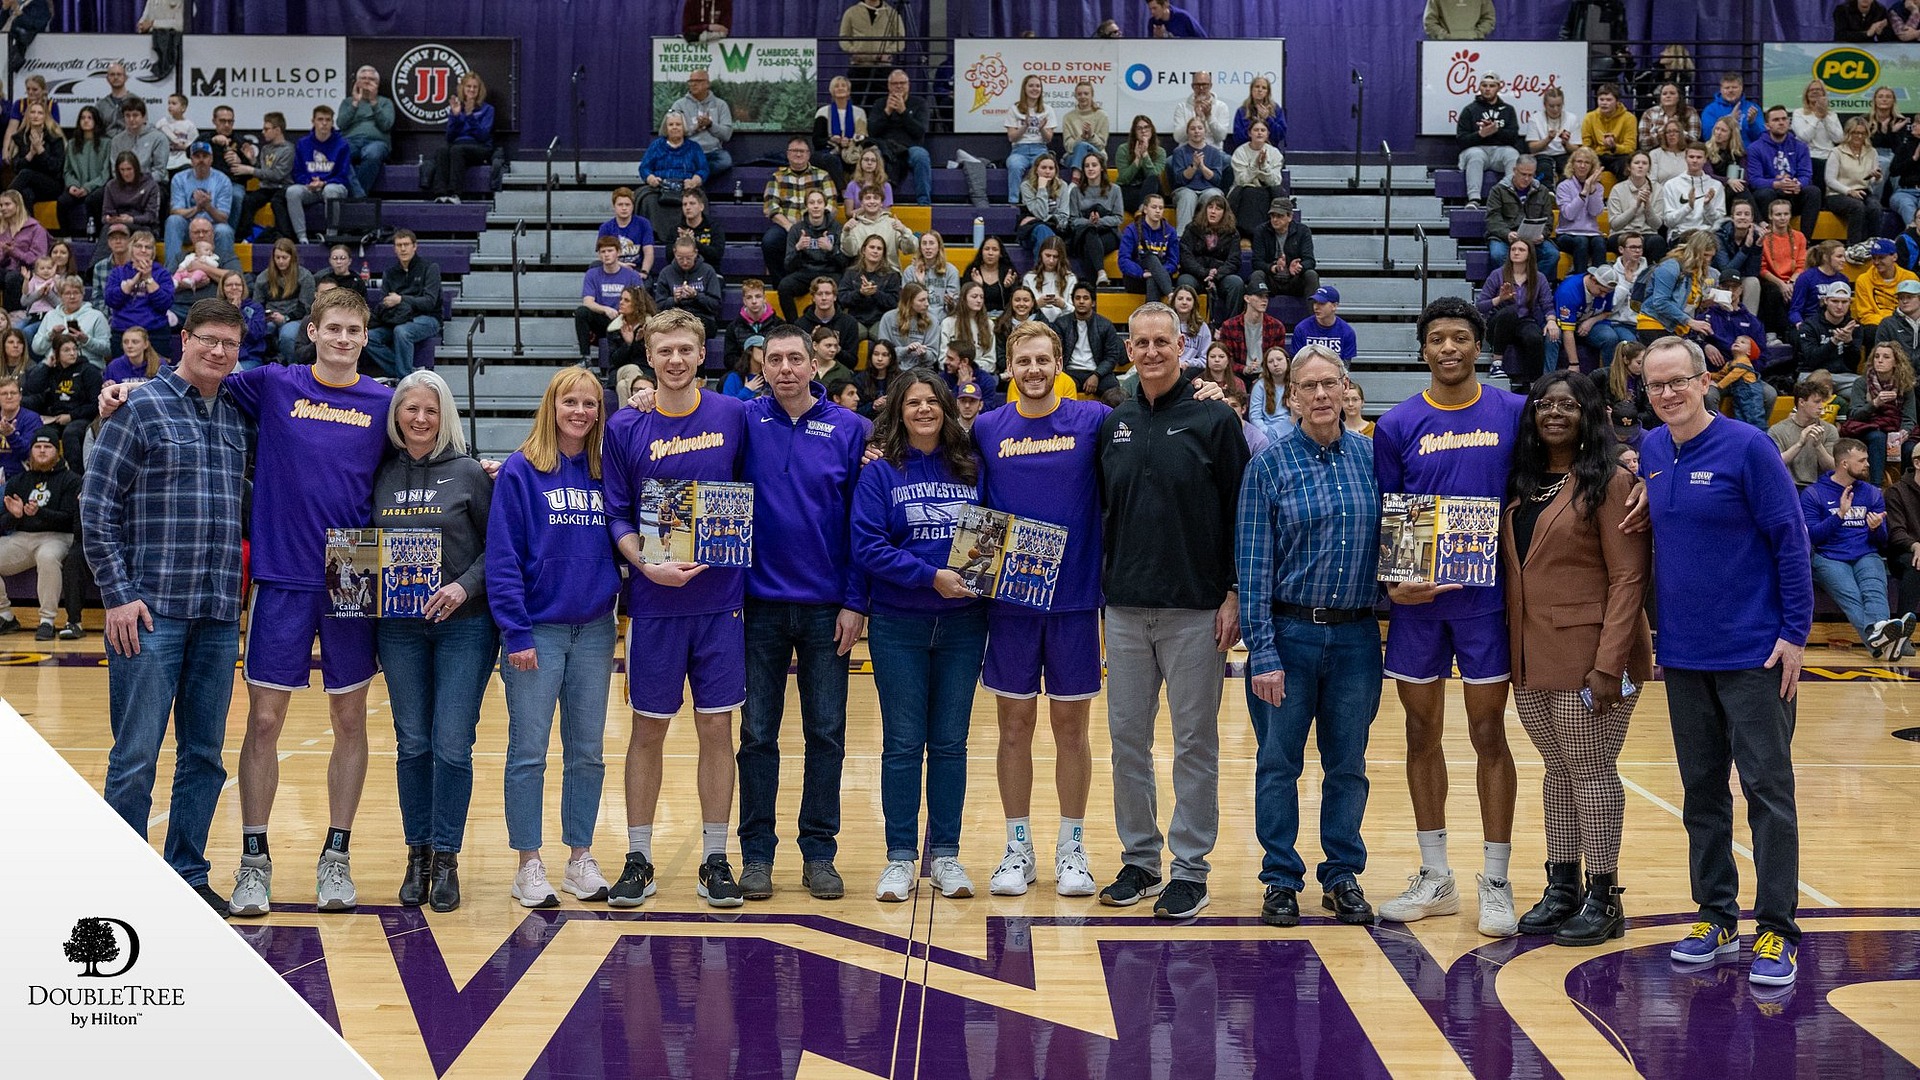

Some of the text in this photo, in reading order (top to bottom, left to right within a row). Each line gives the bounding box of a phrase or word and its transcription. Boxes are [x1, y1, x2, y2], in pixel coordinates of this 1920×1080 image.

[663, 43, 708, 53] WOLCYN
[756, 49, 815, 57] CAMBRIDGE, MN
[659, 54, 713, 63] TREE FARMS
[397, 50, 429, 85] JIMMY
[1023, 62, 1112, 71] COLD STONE
[1822, 60, 1869, 79] PCL
[231, 67, 337, 83] MILLSOP
[1039, 75, 1106, 84] REAMERY
[231, 88, 337, 98] CHIROPRACTIC
[290, 398, 372, 428] Northwestern
[1113, 430, 1132, 438] UNW
[650, 431, 724, 462] Northwestern
[998, 435, 1075, 458] Northwestern
[1418, 428, 1499, 456] Northwestern
[393, 488, 438, 503] UNW
[890, 481, 979, 507] NORTHWESTERN
[912, 526, 956, 540] EAGLE
[1391, 567, 1414, 578] Henry
